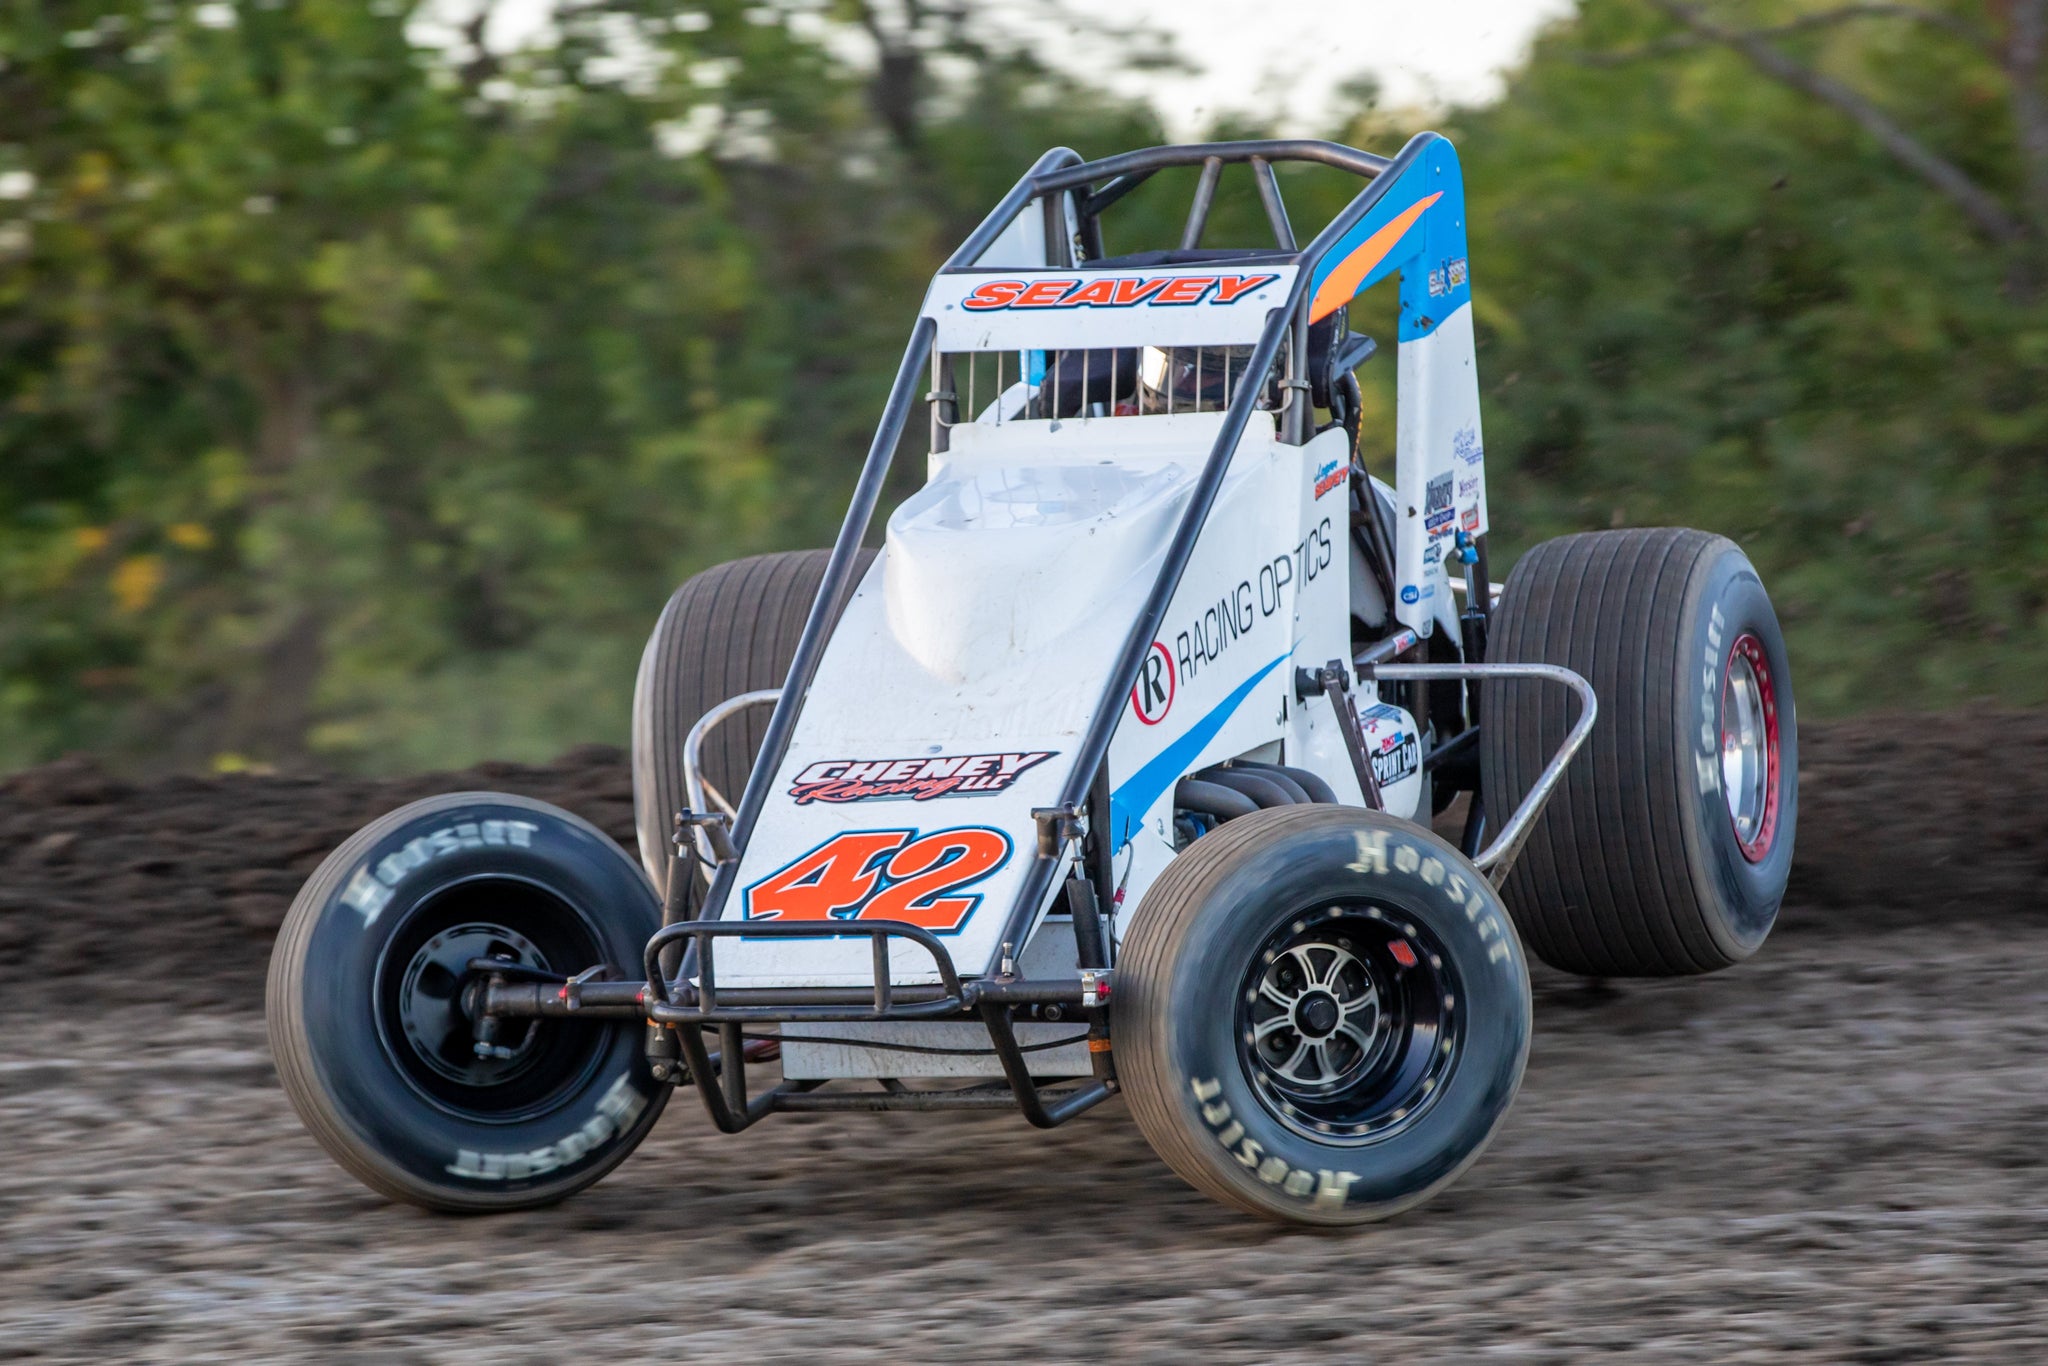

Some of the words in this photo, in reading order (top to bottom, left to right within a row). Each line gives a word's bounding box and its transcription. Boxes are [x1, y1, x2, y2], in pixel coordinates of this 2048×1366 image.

[962, 273, 1281, 311] SEAVEY
[1142, 654, 1166, 715] R
[1177, 580, 1254, 687] RACING
[1259, 517, 1332, 618] OPTICS
[794, 751, 1061, 784] CHENEY
[1402, 742, 1418, 770] CAR
[787, 774, 962, 806] Racing
[957, 773, 1013, 791] LLC
[742, 825, 1014, 940] 42
